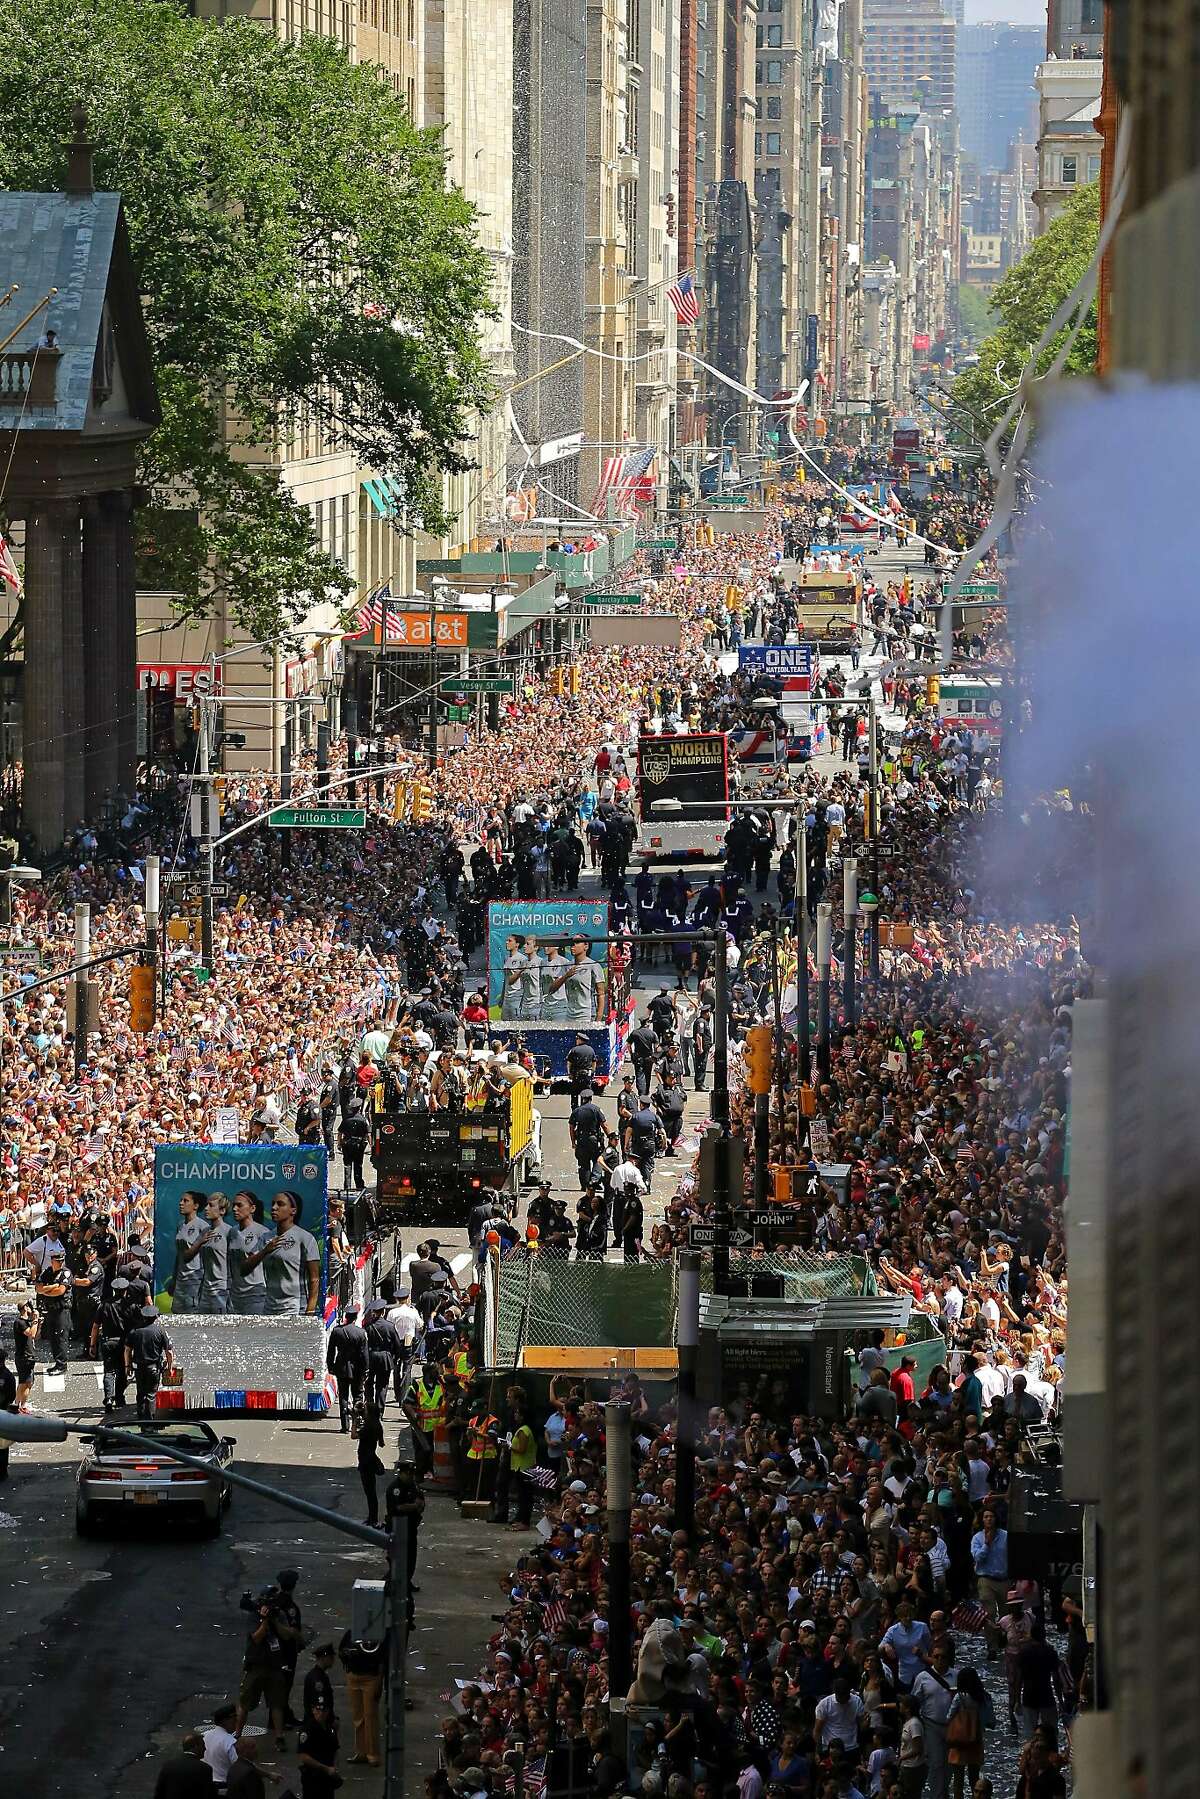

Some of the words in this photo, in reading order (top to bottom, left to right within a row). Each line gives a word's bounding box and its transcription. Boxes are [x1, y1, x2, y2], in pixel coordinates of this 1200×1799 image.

[765, 649, 808, 666] ONE
[460, 682, 482, 692] Vesey
[670, 742, 722, 756] WORLD
[670, 755, 722, 766] CHAMPIONS
[293, 814, 326, 823] Fulton
[492, 914, 574, 926] CHAMPIONS
[161, 1162, 276, 1180] CHAMPIONS
[753, 1215, 785, 1225] JOHN
[696, 1231, 714, 1240] ONE
[825, 1346, 833, 1394] Newsstand
